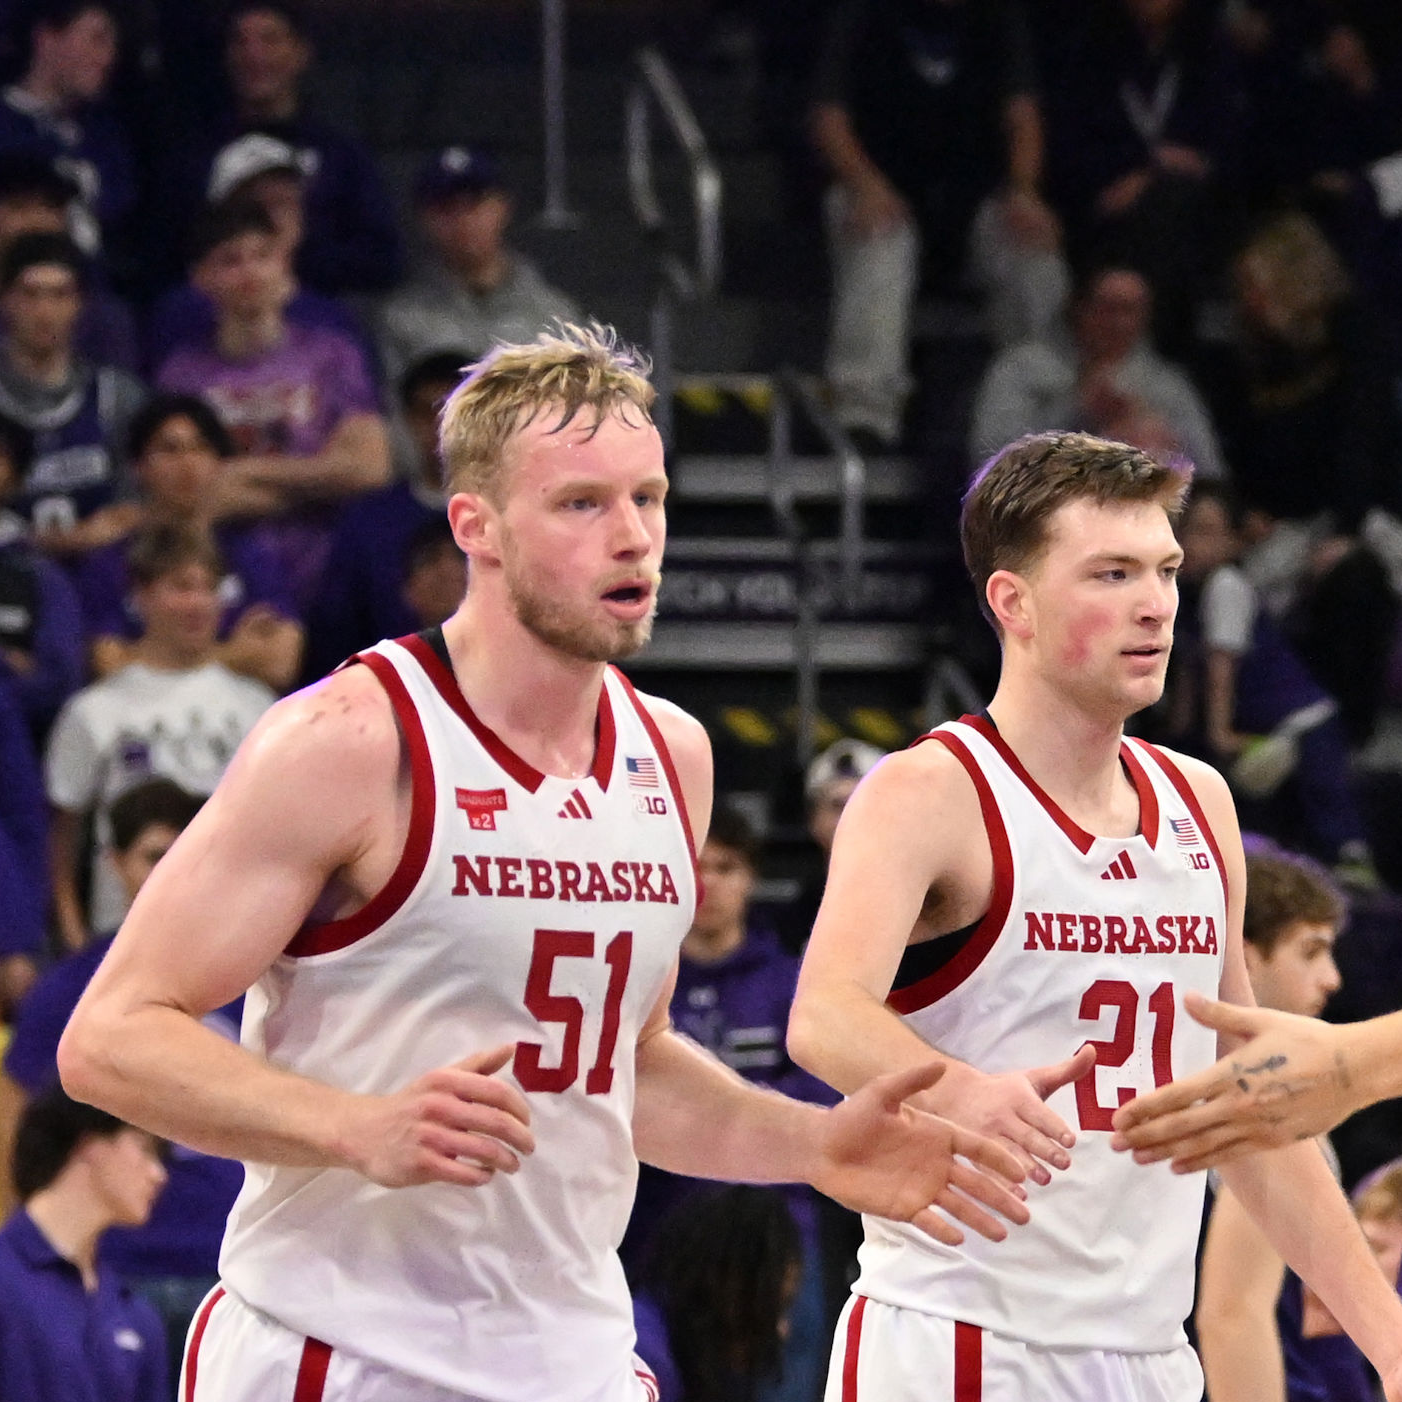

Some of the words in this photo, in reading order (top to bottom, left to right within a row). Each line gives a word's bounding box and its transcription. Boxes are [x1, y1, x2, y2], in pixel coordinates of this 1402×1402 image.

[452, 855, 680, 905] NEBRASKA
[1023, 911, 1219, 956] NEBRASKA
[512, 929, 634, 1096] 51
[1073, 979, 1176, 1133] 21
